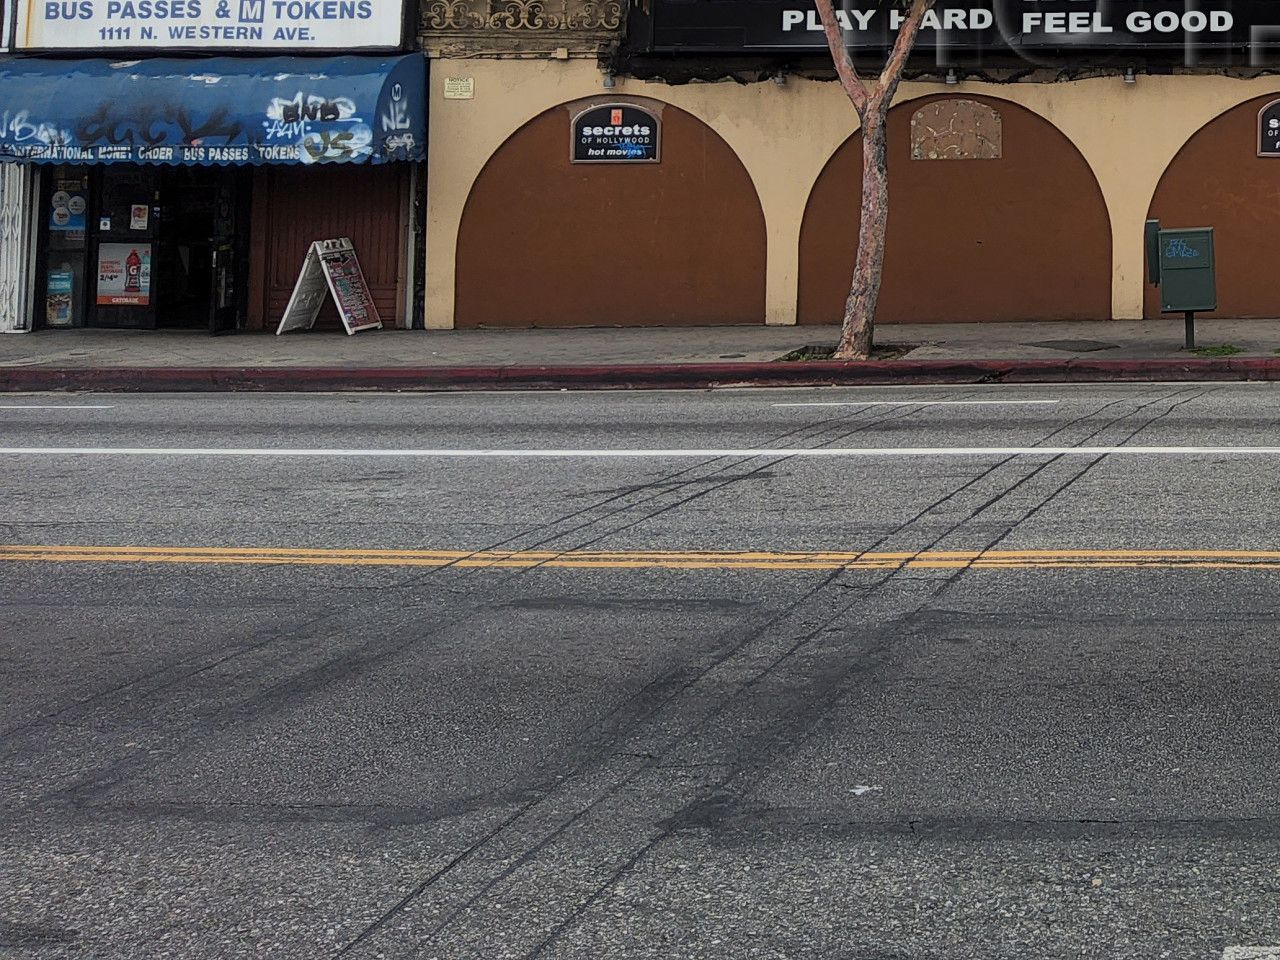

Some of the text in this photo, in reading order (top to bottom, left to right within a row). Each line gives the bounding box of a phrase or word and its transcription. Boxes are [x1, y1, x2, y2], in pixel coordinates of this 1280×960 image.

[44, 0, 93, 20] BUS
[107, 0, 201, 19] PASSES
[215, 0, 231, 19] &
[272, 0, 372, 19] TOKENS
[782, 9, 876, 31] PLAY
[1022, 10, 1234, 33] FEEL GOOD
[99, 26, 316, 40] 1111 N. WESTERN AVE.
[582, 124, 651, 136] secrets
[183, 147, 205, 160] BUS
[208, 147, 249, 160] PASSES
[259, 144, 301, 159] TOKENS
[588, 148, 605, 156] hot
